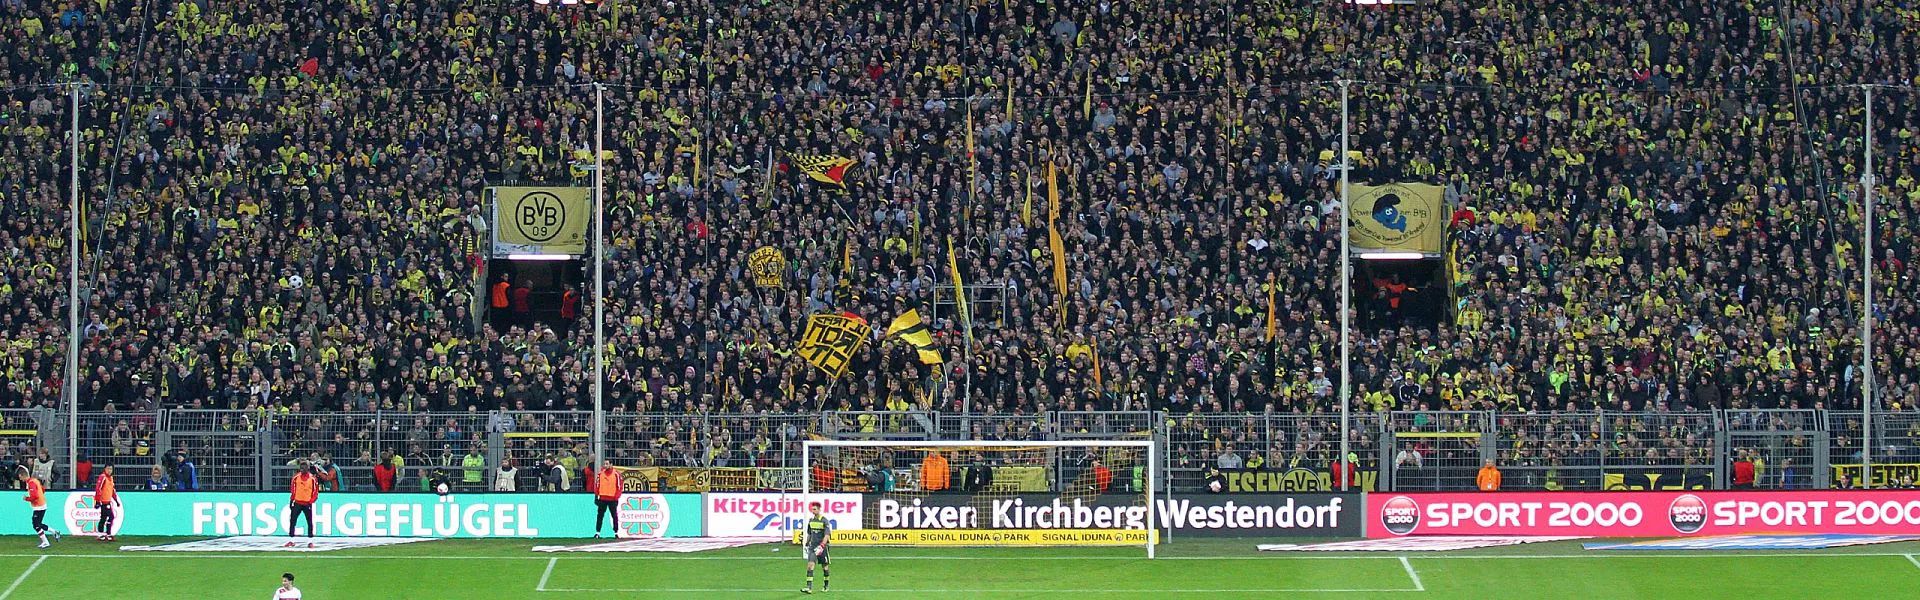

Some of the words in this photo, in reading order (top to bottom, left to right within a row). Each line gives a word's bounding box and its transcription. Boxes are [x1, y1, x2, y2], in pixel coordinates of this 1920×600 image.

[523, 197, 557, 226] BVB
[532, 226, 548, 236] 09
[1284, 472, 1318, 491] BVB
[879, 498, 977, 529] Brixen
[992, 498, 1147, 530] Kirchberg
[1157, 497, 1342, 529] Westendorf
[1384, 507, 1417, 516] SPORT
[1426, 502, 1542, 527] SPORT
[1548, 502, 1643, 527] 2000
[1672, 506, 1704, 515] SPORT
[1713, 500, 1829, 526] SPORT
[1834, 501, 1920, 526] 2000
[620, 512, 659, 520] Astenhof
[1387, 515, 1414, 524] 2000
[1675, 514, 1701, 522] 2000
[837, 531, 868, 541] IDUNA
[881, 531, 908, 541] PARK
[920, 533, 957, 542] SIGNAL
[959, 533, 991, 541] IDUNA
[1003, 533, 1030, 541] PARK
[1042, 533, 1079, 541] SIGNAL
[1081, 533, 1113, 541] IDUNA
